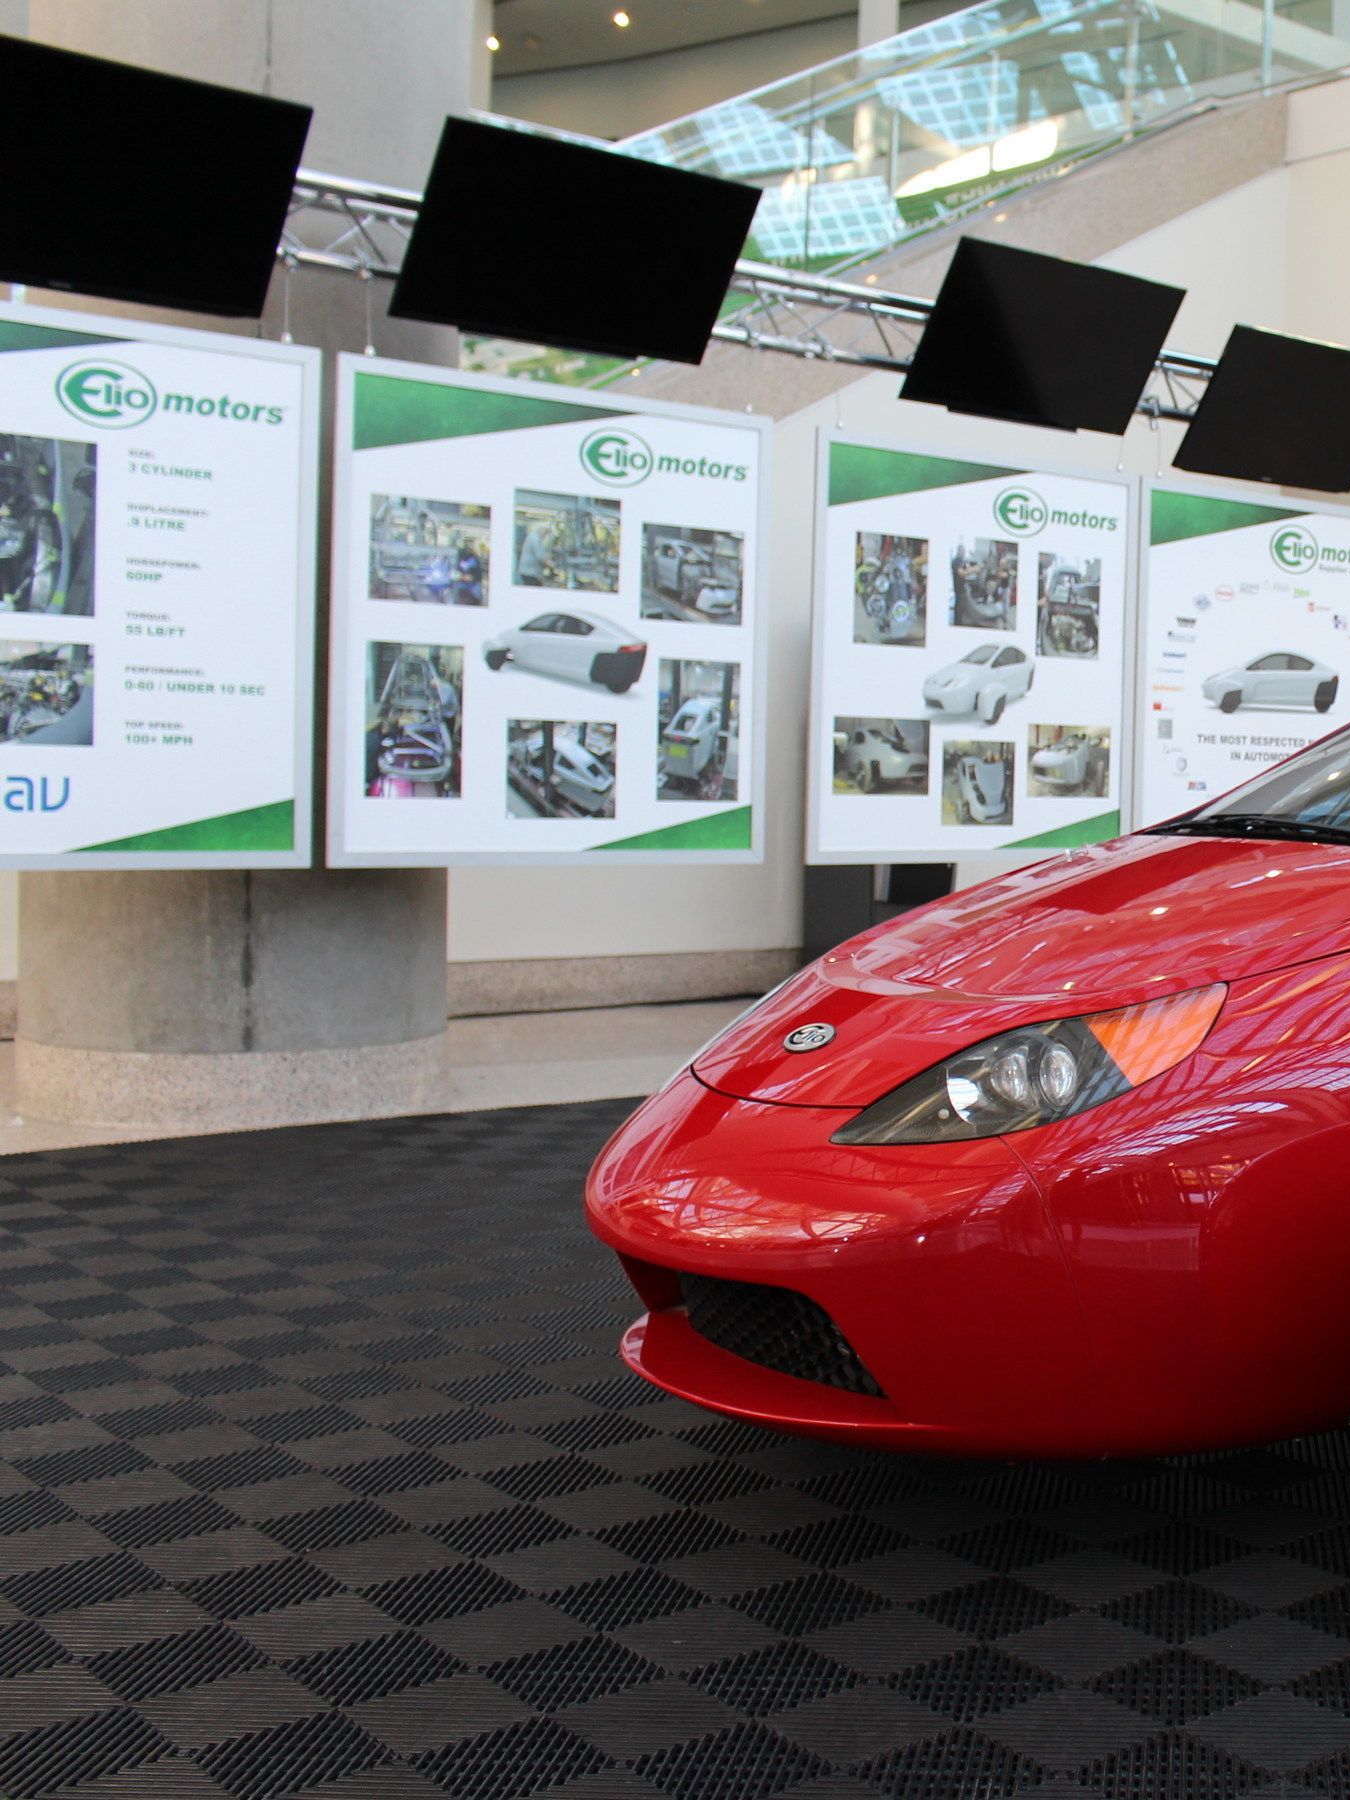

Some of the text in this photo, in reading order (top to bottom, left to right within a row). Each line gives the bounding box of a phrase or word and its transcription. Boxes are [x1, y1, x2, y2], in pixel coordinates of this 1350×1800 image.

[162, 391, 283, 425] motors
[141, 463, 212, 480] CYLINDER
[658, 455, 747, 481] motors
[144, 518, 185, 531] LITRE
[1051, 510, 1117, 531] motors
[167, 681, 214, 694] UNDER
[220, 683, 234, 695] 10
[239, 685, 265, 696] SEC
[162, 734, 193, 746] MPH
[1198, 734, 1217, 744] THE
[1220, 735, 1246, 745] MOST
[1250, 736, 1305, 748] RESPECTED
[1231, 751, 1241, 761] IN
